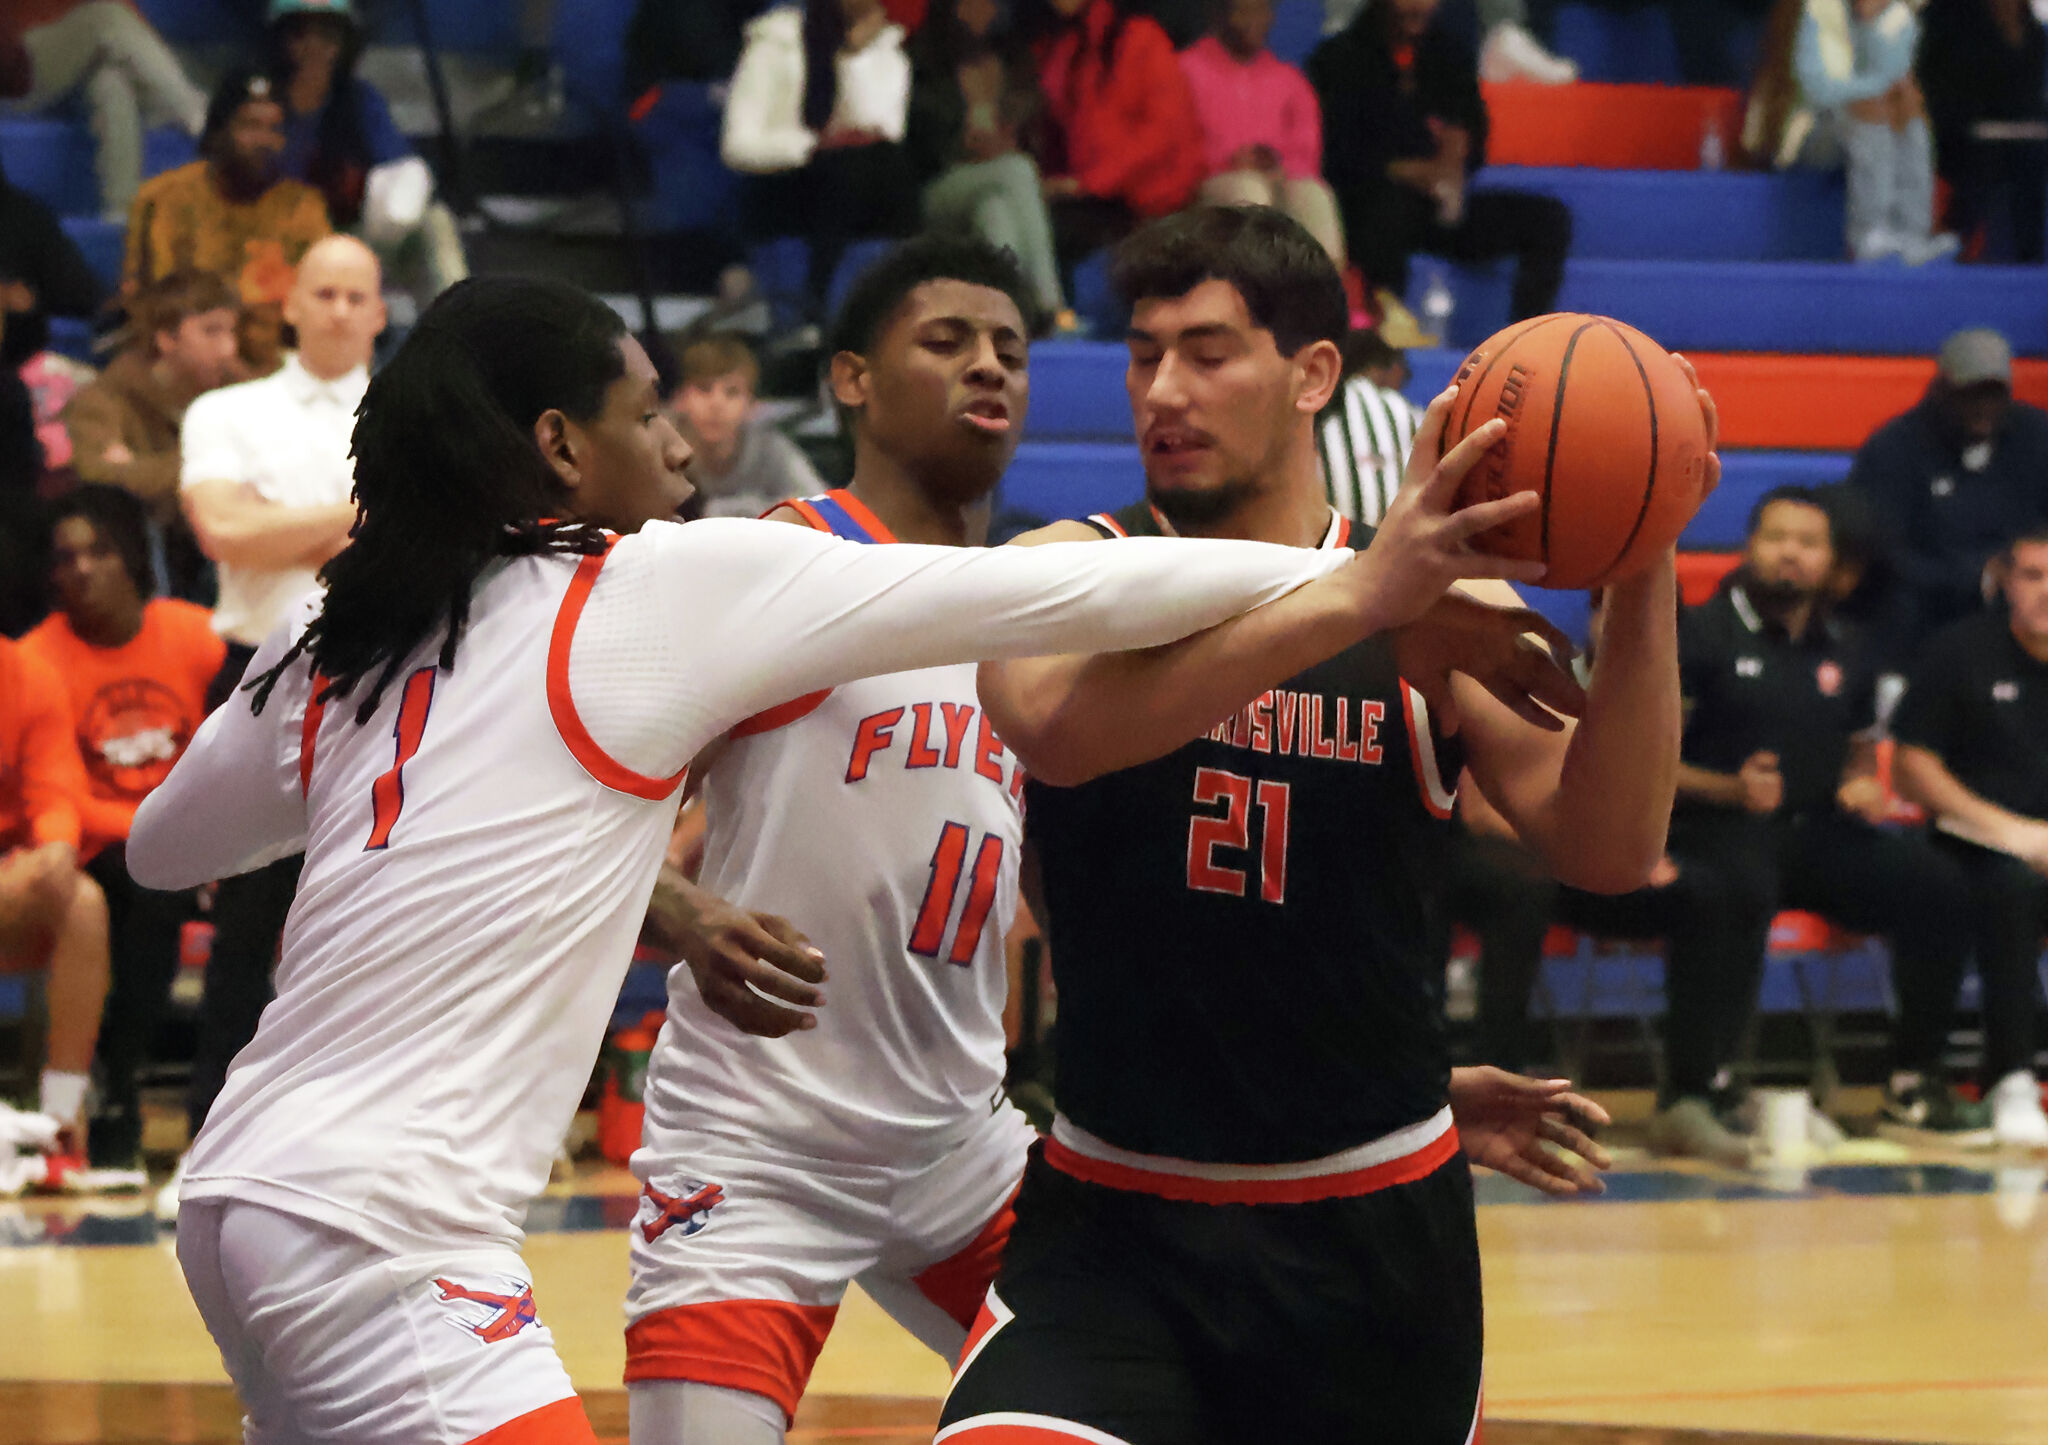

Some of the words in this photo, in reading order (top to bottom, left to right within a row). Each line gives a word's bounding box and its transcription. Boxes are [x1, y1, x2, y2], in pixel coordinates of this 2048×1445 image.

[363, 665, 438, 852] 1
[907, 820, 1004, 967] 11
[1187, 767, 1290, 904] 21
